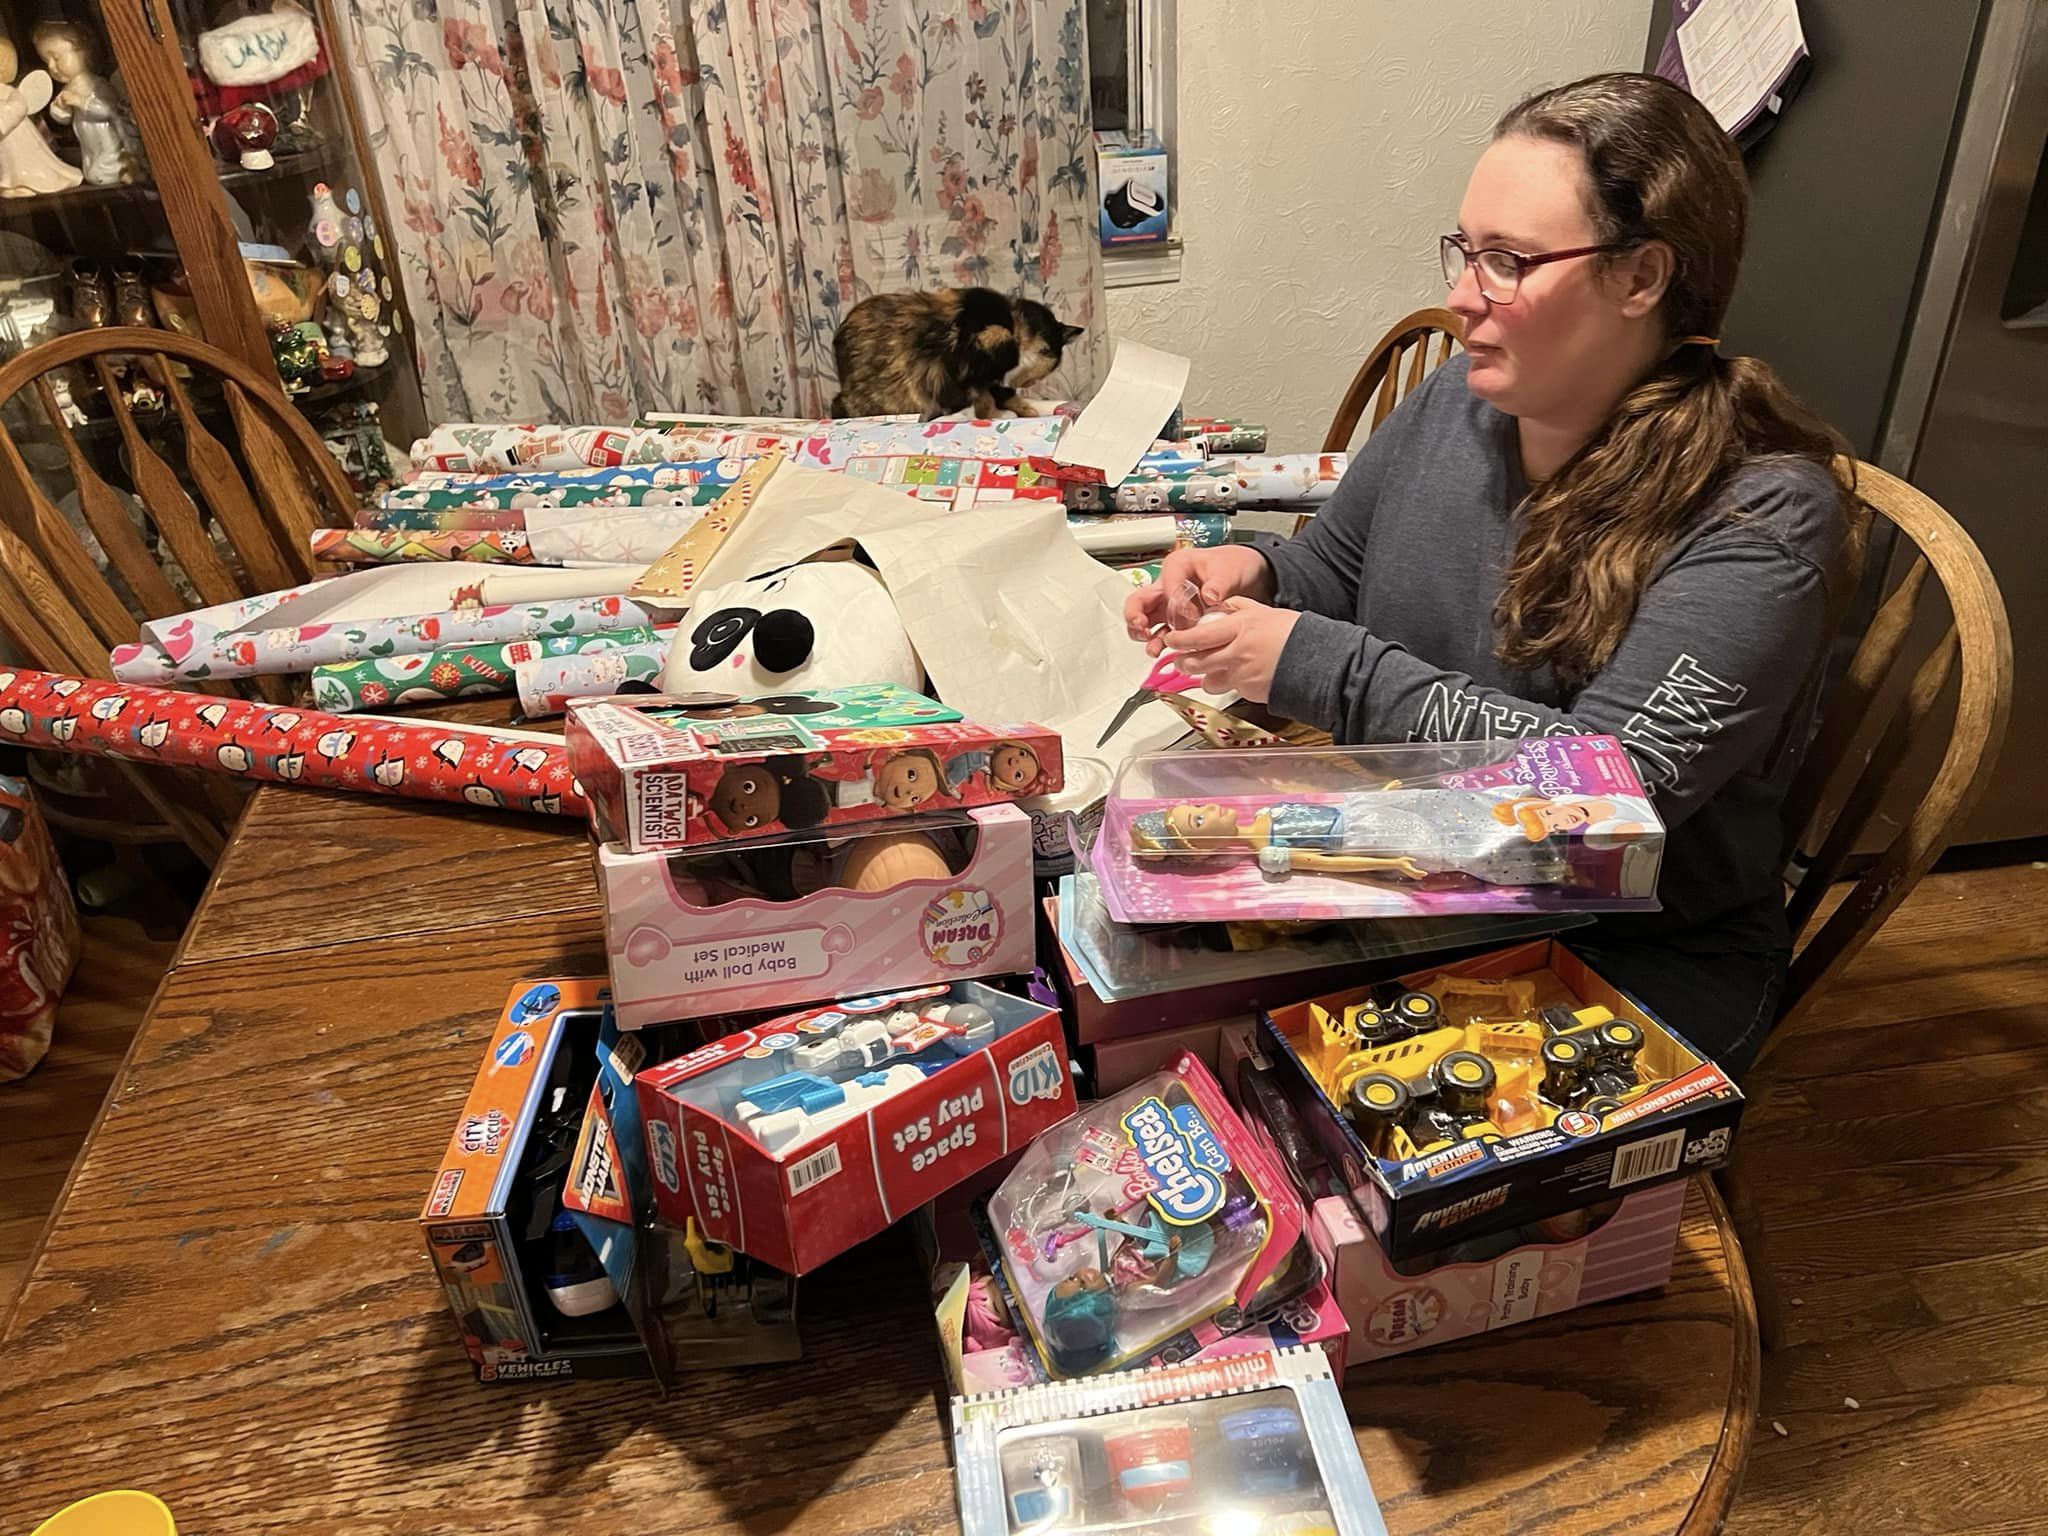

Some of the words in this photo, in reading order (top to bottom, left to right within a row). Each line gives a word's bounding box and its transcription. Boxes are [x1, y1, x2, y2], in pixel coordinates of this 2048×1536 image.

[1523, 740, 1573, 797] PRINCESS
[663, 775, 682, 799] ADA
[644, 775, 662, 840] SCIENTIST
[931, 921, 991, 946] DREAM
[934, 908, 984, 929] Collection
[692, 948, 719, 964] Set
[722, 939, 787, 961] Medical
[758, 953, 797, 973] Baby
[683, 966, 719, 984] with
[722, 962, 754, 979] Doll
[1011, 1053, 1061, 1104] KID
[935, 1088, 984, 1129] Play
[1611, 1110, 1637, 1125] MINI
[1635, 1074, 1718, 1114] CONSTRUCTION
[465, 1120, 482, 1152] CITY
[891, 1115, 932, 1151] Set
[1187, 1107, 1209, 1142] Be...
[1568, 1112, 1583, 1131] 5
[580, 1118, 609, 1211] MONSTER
[911, 1125, 977, 1174] Space
[1132, 1104, 1209, 1214] Chelsea
[1205, 1143, 1227, 1168] Can
[1402, 1140, 1479, 1182] ADVENTURE
[1434, 1152, 1479, 1175] FORCE
[597, 1151, 612, 1197] JAM
[691, 1129, 709, 1180] Play
[704, 1183, 723, 1220] Set
[711, 1147, 732, 1214] Space
[1114, 1148, 1159, 1202] Barbie
[1411, 1183, 1513, 1233] ADVENTURE
[481, 1364, 497, 1381] 5
[498, 1360, 571, 1374] VEHICLES
[1225, 1356, 1269, 1384] mini
